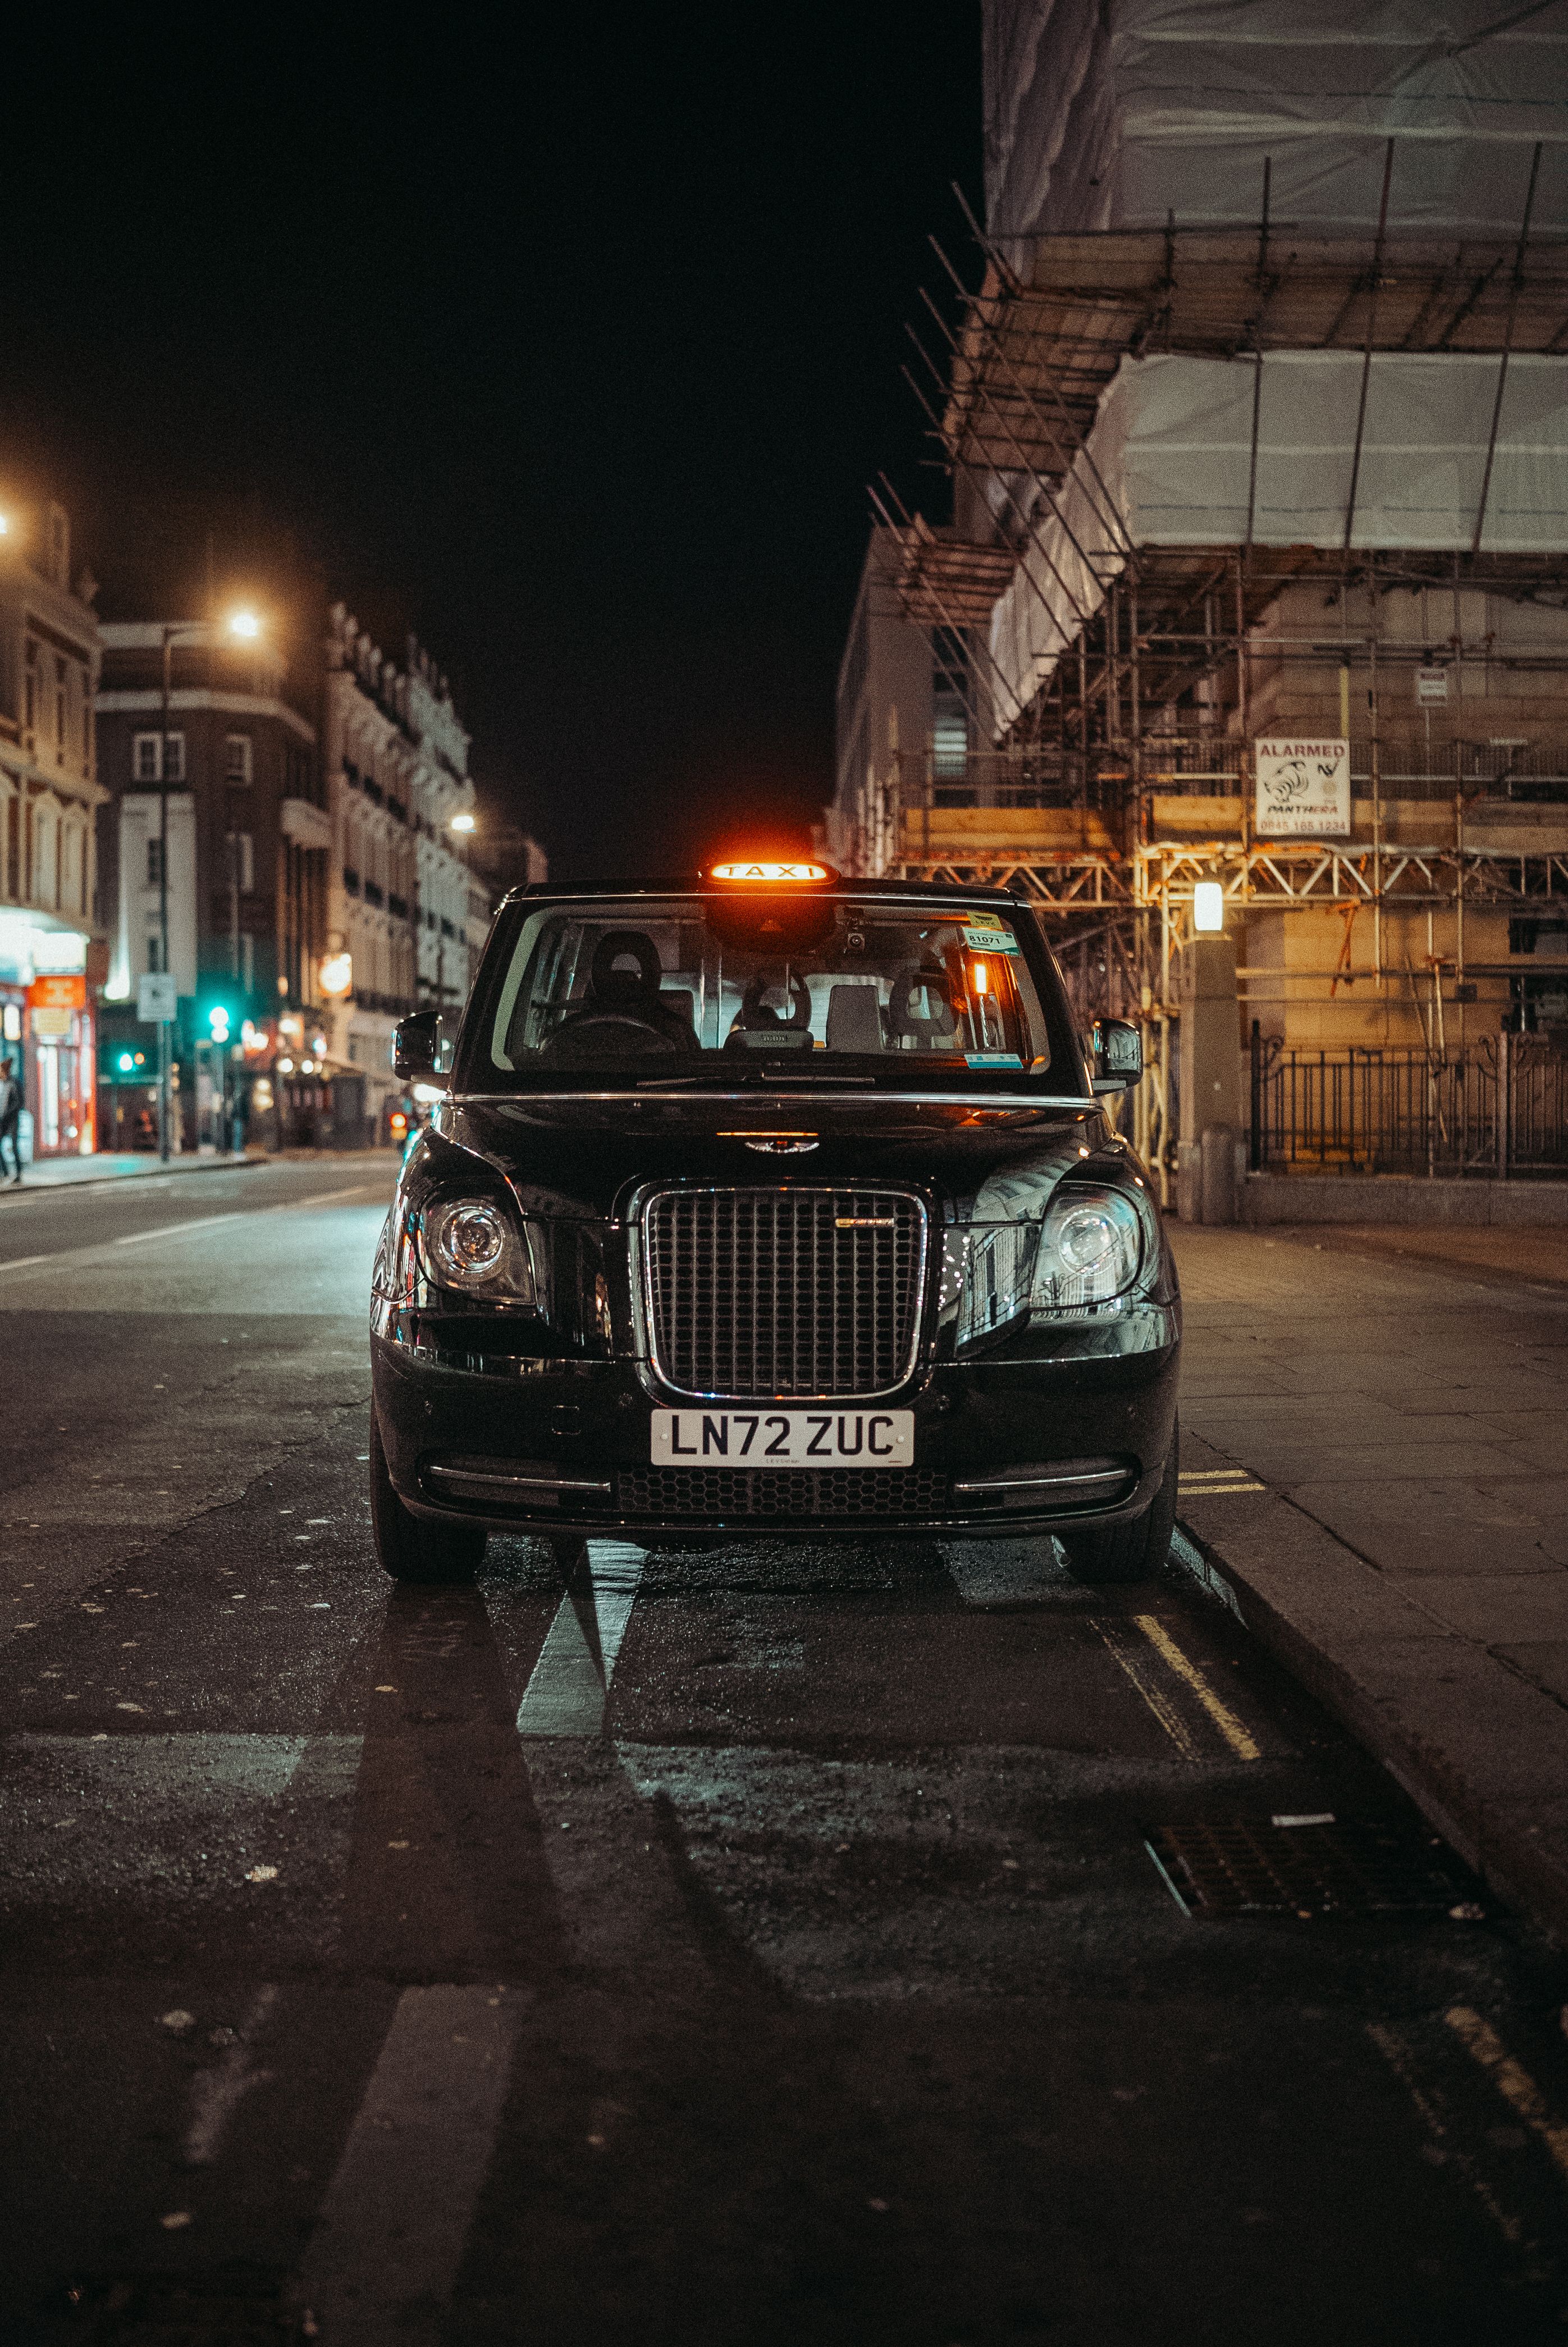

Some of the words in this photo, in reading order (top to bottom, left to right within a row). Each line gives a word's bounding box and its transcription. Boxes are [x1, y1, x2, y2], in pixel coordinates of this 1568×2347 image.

[1261, 744, 1345, 757] ALARMED
[723, 866, 815, 877] TAXI
[969, 935, 1000, 944] 81071
[671, 1415, 791, 1456] LN72
[806, 1415, 894, 1456] ZUC
